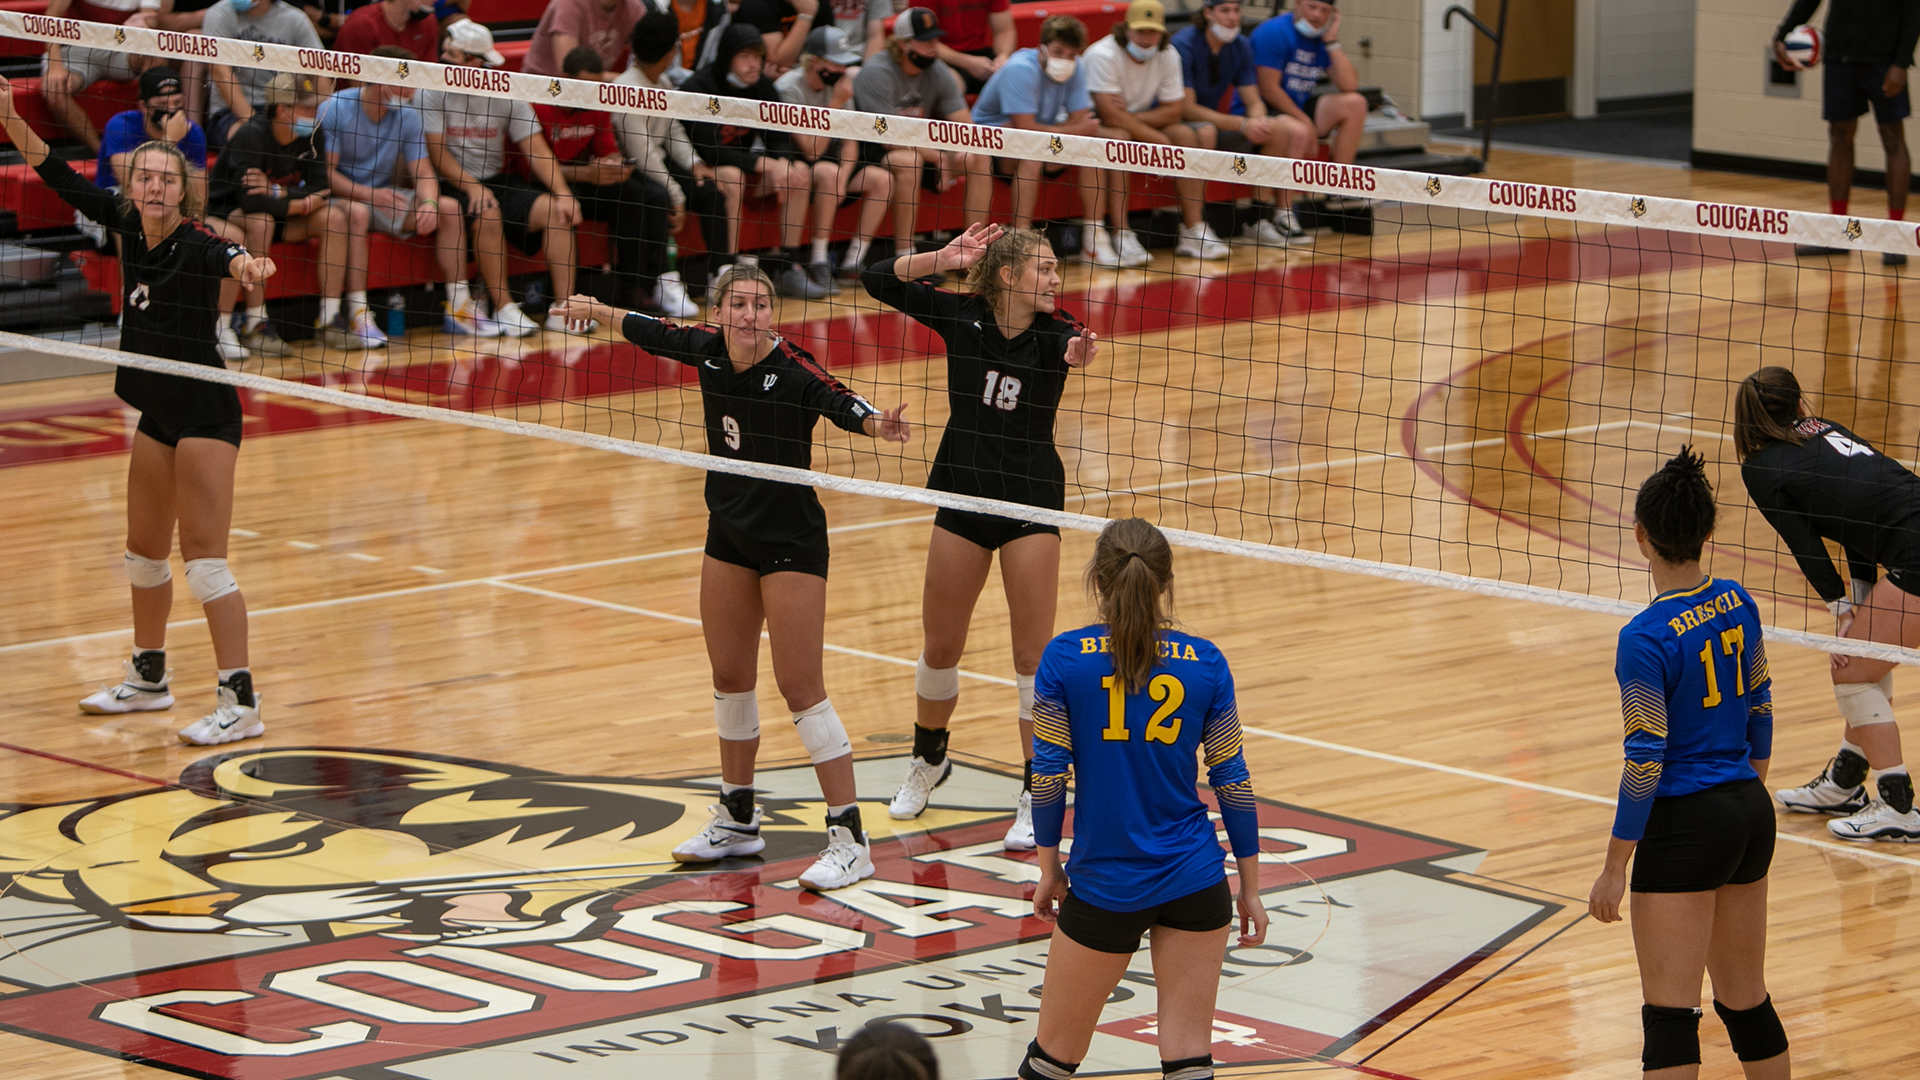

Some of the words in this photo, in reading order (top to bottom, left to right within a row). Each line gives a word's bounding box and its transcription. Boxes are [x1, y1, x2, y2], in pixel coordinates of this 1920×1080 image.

[22, 13, 82, 41] COUGARS
[157, 31, 218, 58] COUGARS
[297, 48, 362, 75] COUGARS
[444, 66, 511, 93] COUGARS
[598, 83, 668, 112] COUGARS
[758, 101, 831, 131] COUGARS
[927, 119, 1004, 151] COUGARS
[1105, 140, 1187, 171] COUGARS
[1291, 159, 1376, 192] COUGARS
[1488, 181, 1577, 214] COUGARS
[1695, 202, 1789, 236] COUGARS
[982, 369, 1022, 411] 18
[721, 414, 742, 452] 9
[1822, 430, 1876, 458] 4
[1667, 589, 1744, 637] BRESCIA
[1079, 636, 1200, 661] BRCIA
[1698, 623, 1745, 710] 17
[1101, 672, 1185, 746] 12
[532, 992, 896, 1064] INDIANA
[902, 895, 1355, 991] UNITY
[772, 944, 1314, 1057] KOKO
